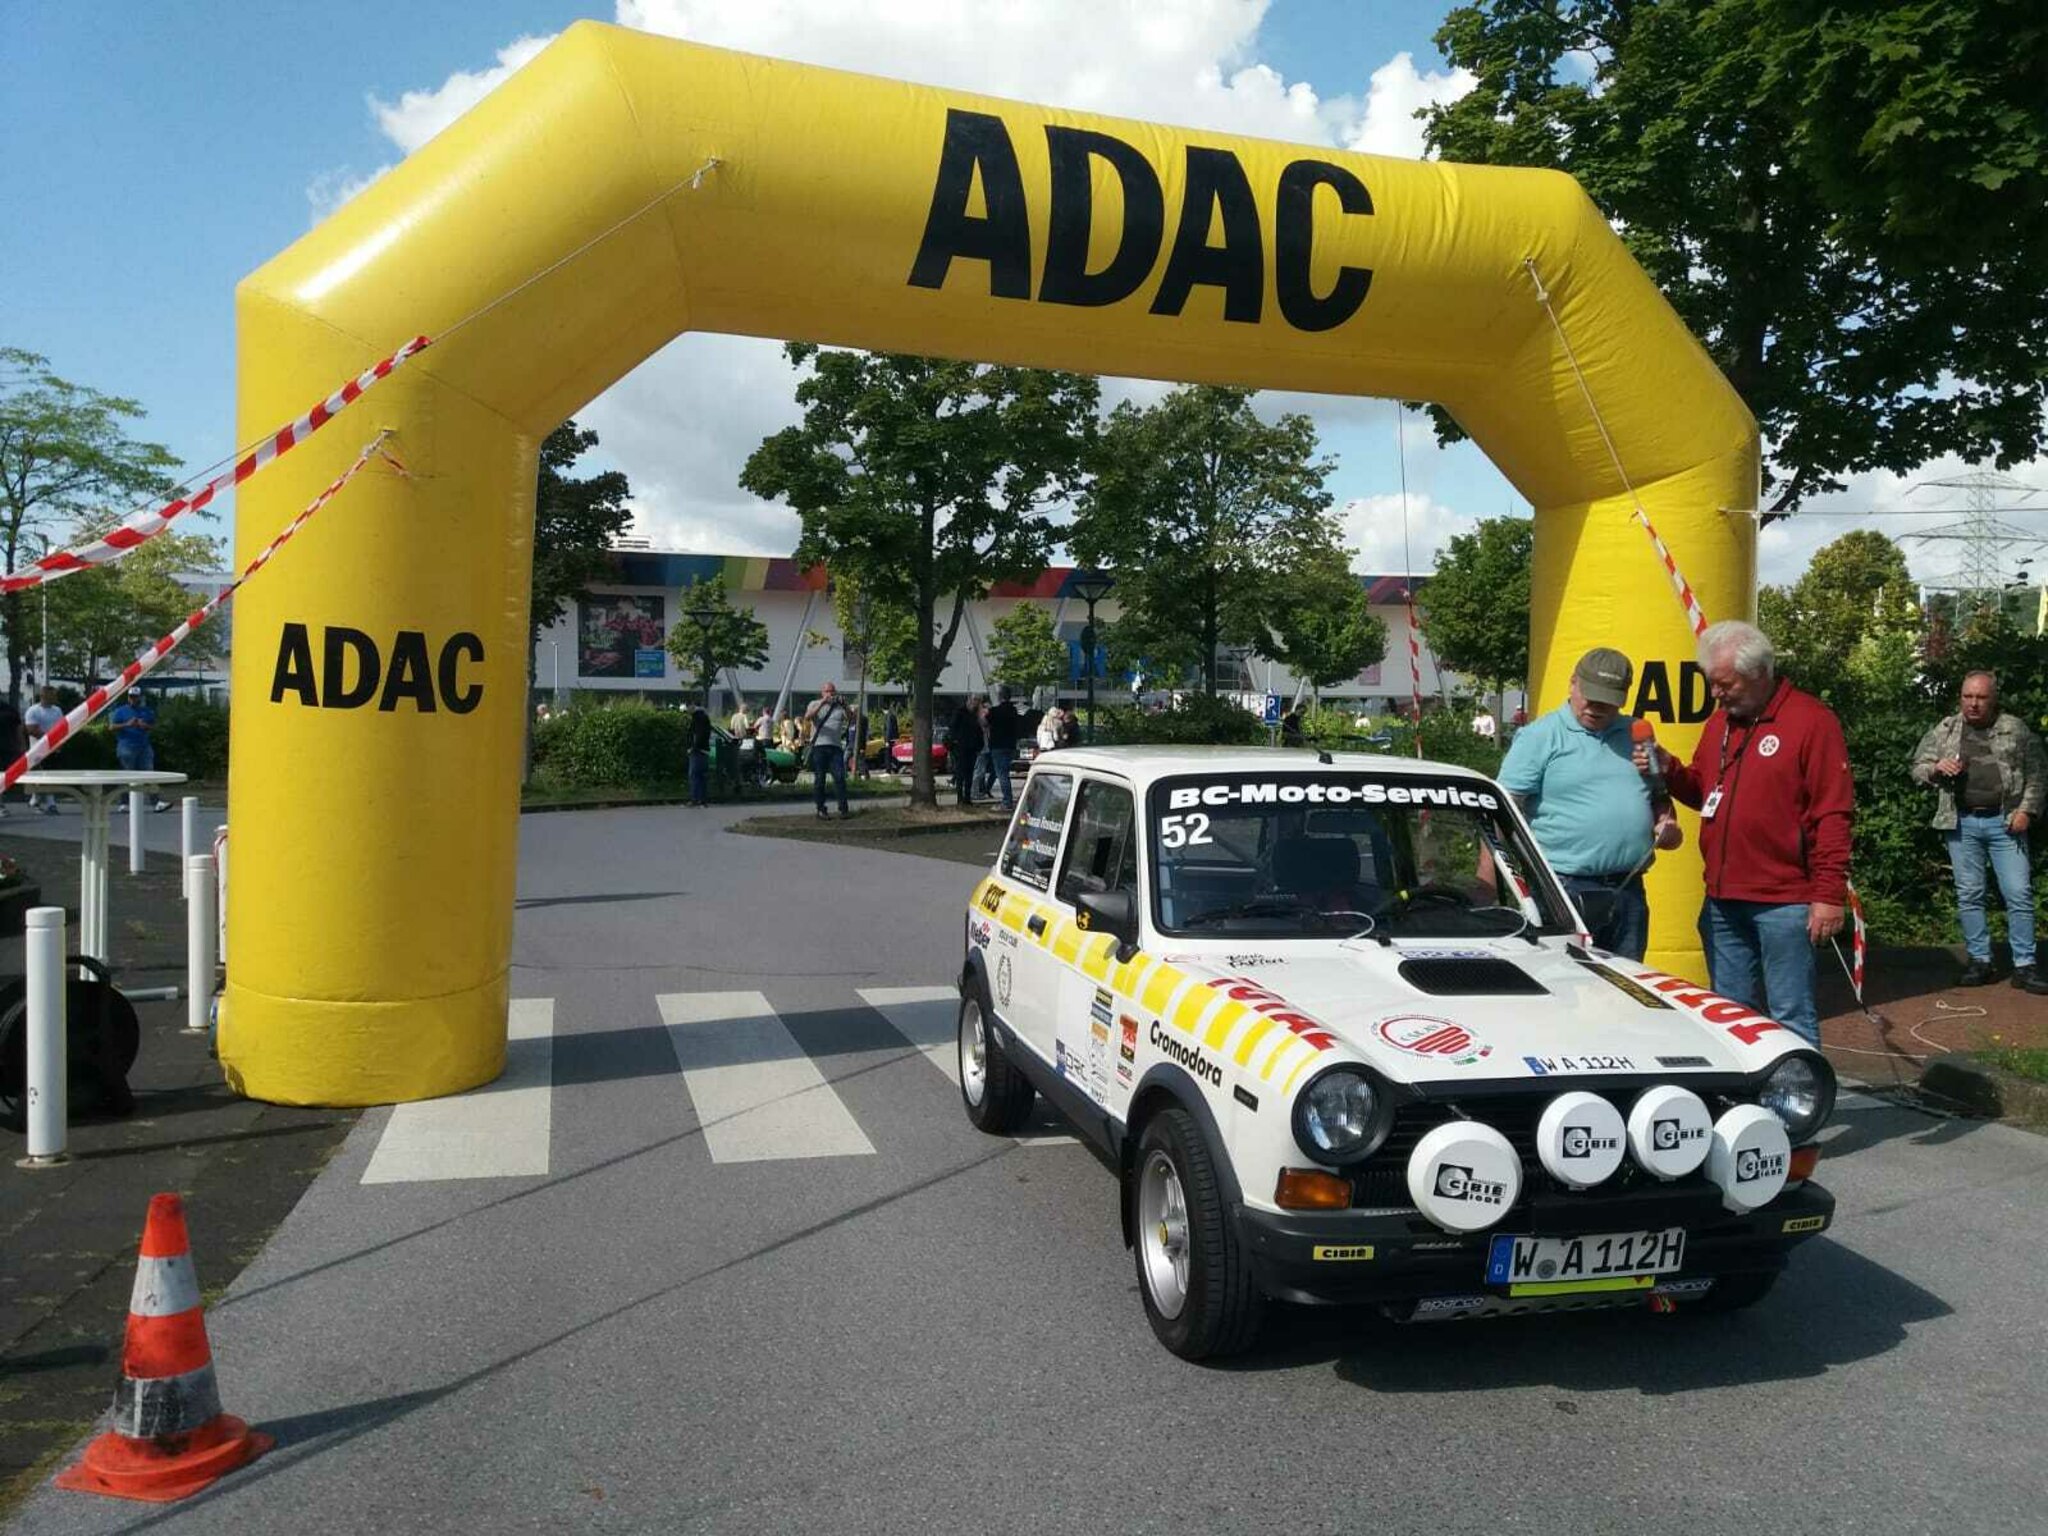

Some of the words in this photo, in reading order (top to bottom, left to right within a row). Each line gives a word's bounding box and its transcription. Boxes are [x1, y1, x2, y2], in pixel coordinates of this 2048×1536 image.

[907, 108, 1375, 332] ADAC
[270, 622, 485, 715] ADAC
[1632, 660, 1717, 723] AD
[1169, 783, 1499, 810] BC-Moto-Service
[1161, 813, 1213, 848] 52
[1206, 976, 1340, 1051] TOTAL
[1150, 1020, 1222, 1088] Cromodora
[1540, 1057, 1558, 1072] W
[1561, 1056, 1579, 1070] A
[1580, 1056, 1635, 1070] 112H
[1514, 1242, 1538, 1277] W
[1561, 1240, 1584, 1275] A
[1591, 1229, 1685, 1274] 112H
